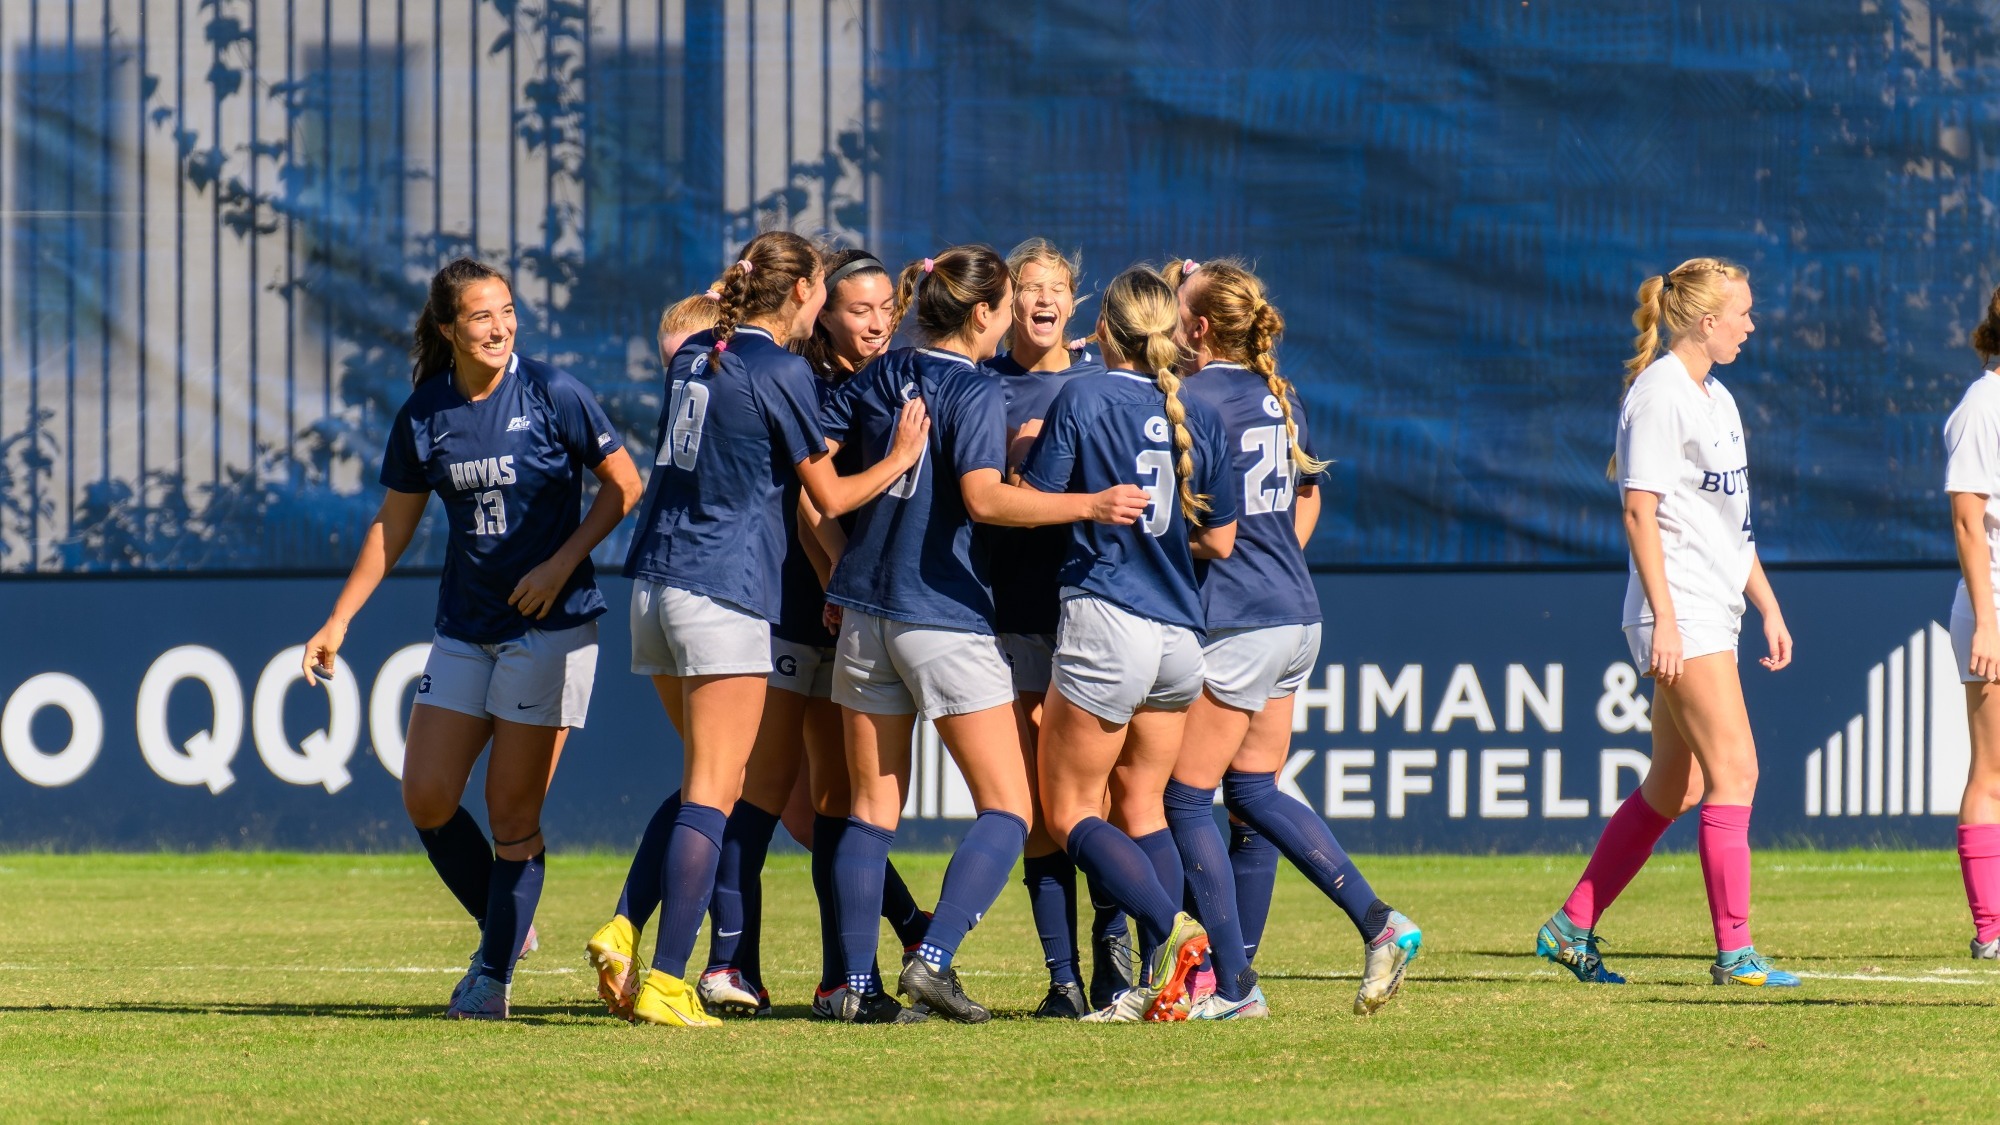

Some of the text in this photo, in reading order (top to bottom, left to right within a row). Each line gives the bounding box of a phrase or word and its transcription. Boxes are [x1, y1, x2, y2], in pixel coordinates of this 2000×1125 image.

[656, 379, 709, 472] 18
[1144, 416, 1169, 442] G
[449, 455, 517, 491] HOYAS
[1241, 424, 1299, 516] 25
[474, 489, 507, 535] 13
[776, 654, 797, 678] G
[1596, 662, 1652, 734] &
